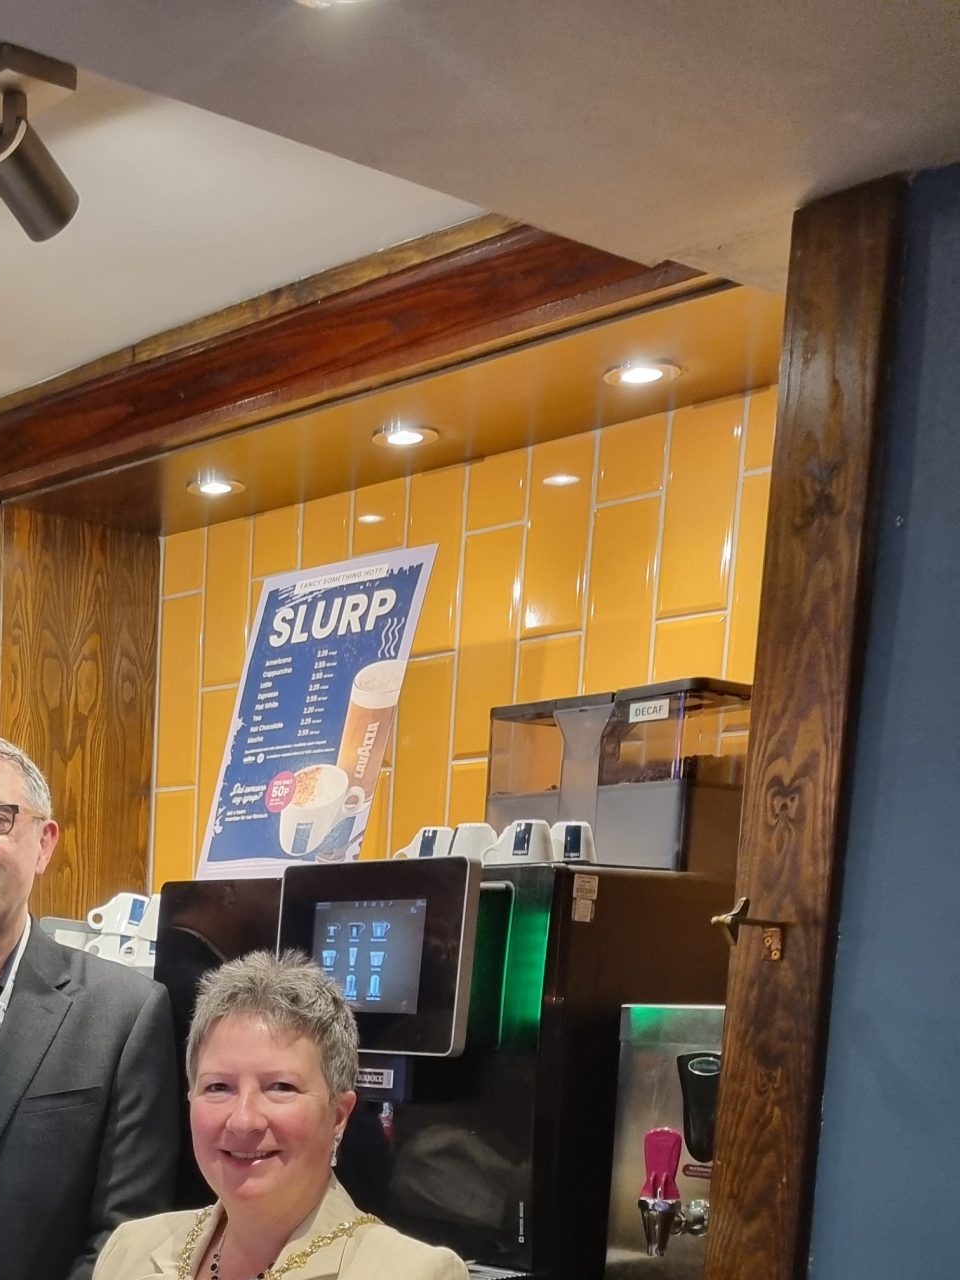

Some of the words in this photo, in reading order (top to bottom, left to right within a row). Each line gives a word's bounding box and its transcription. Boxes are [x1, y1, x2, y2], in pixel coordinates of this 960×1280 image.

[301, 580, 322, 589] FANCY
[323, 571, 362, 585] SOMETHING
[364, 568, 383, 577] HOT?
[269, 589, 397, 648] SLURP
[265, 657, 292, 667] Americano
[263, 668, 292, 678] Cappuccino
[635, 705, 664, 717] DECAF
[259, 722, 284, 731] Chocolate
[247, 736, 264, 744] Mocha
[354, 721, 380, 779] LAVAZZA
